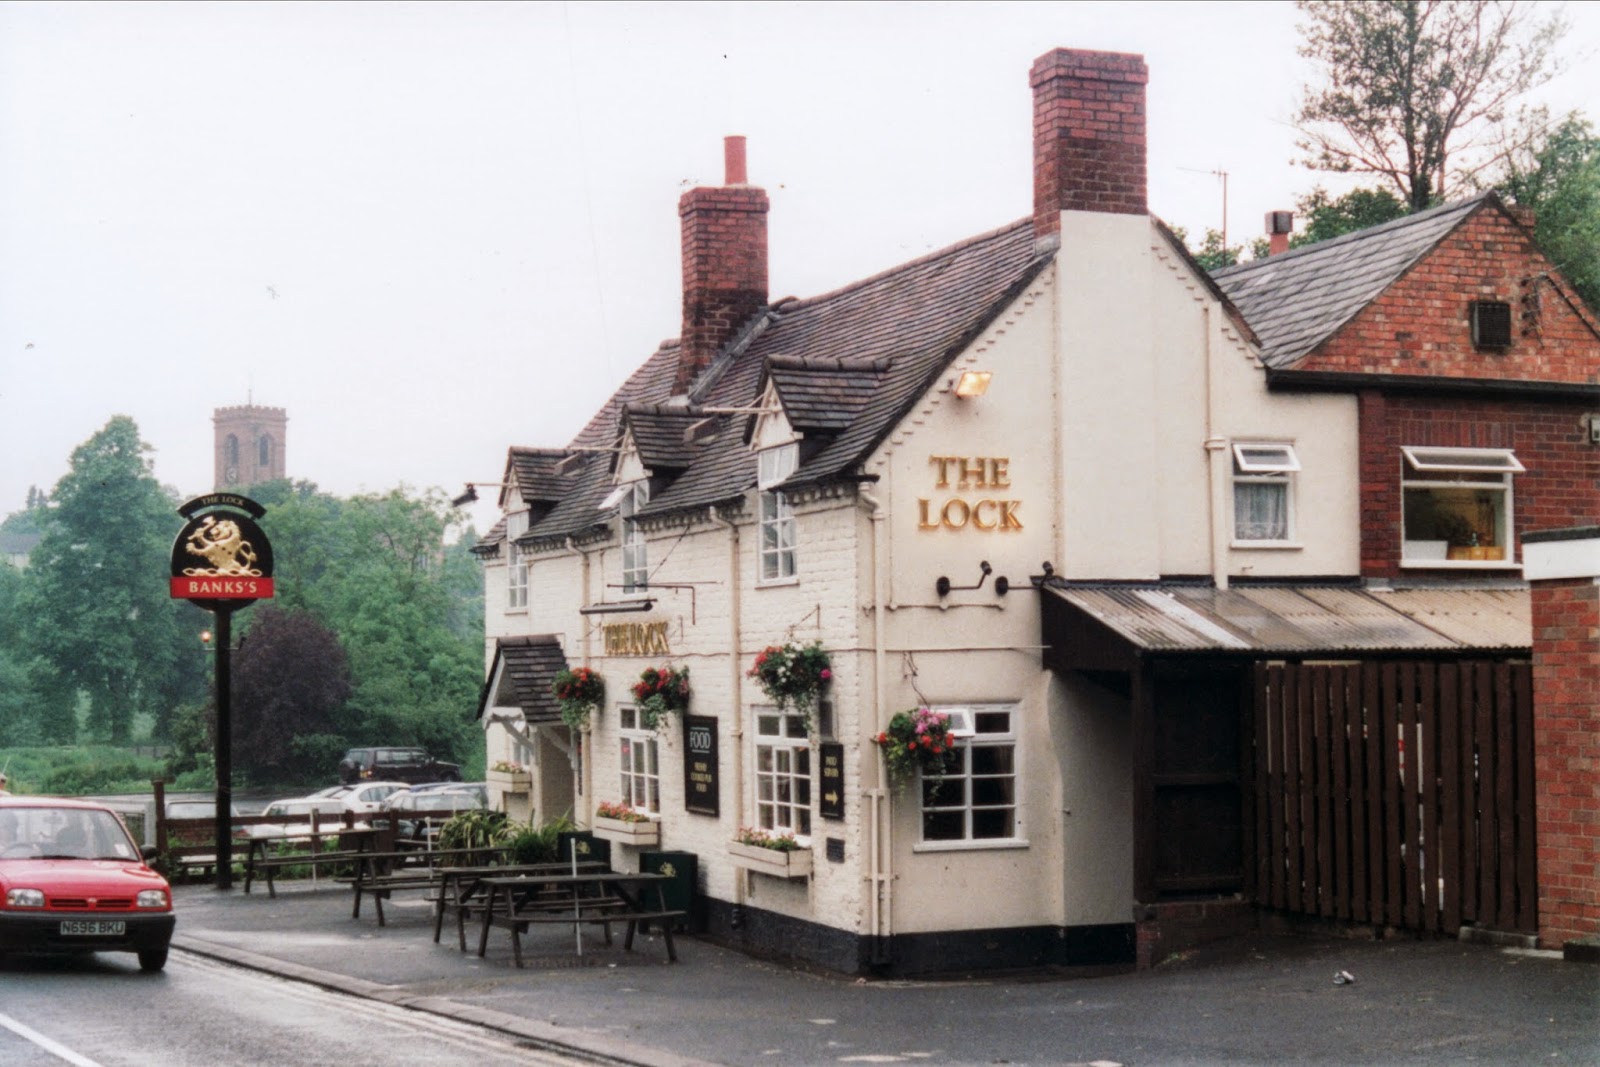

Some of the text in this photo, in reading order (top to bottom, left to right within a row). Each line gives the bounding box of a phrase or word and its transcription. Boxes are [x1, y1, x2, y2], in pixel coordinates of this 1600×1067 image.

[928, 455, 1011, 491] THE
[202, 496, 218, 505] THE
[917, 497, 1024, 532] LOCK
[189, 581, 257, 593] BANKS'S
[689, 731, 711, 750] FOOD
[63, 922, 124, 933] N696 BKU
